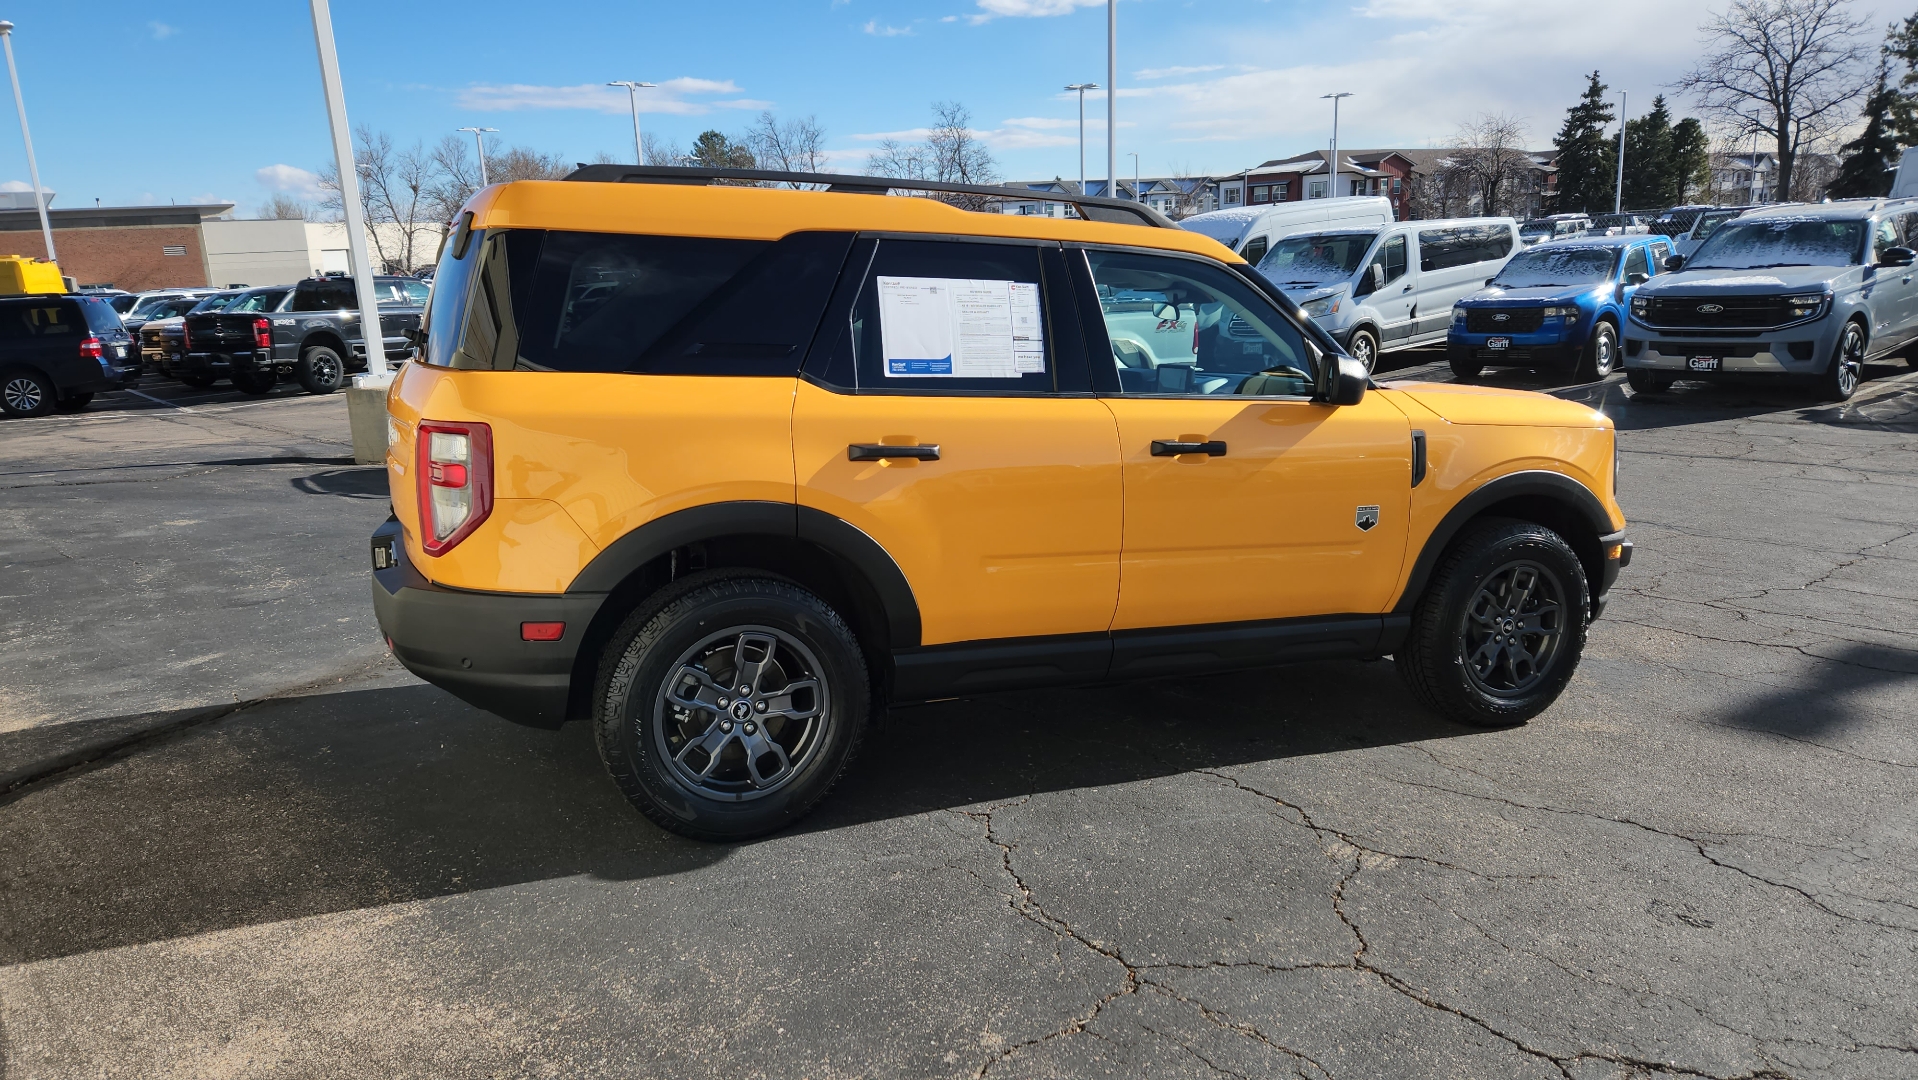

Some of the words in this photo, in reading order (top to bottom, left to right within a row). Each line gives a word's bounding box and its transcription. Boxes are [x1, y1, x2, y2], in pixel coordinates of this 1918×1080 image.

[1156, 320, 1187, 330] FX4
[1487, 339, 1509, 348] Garff
[1689, 358, 1719, 368] Garff
